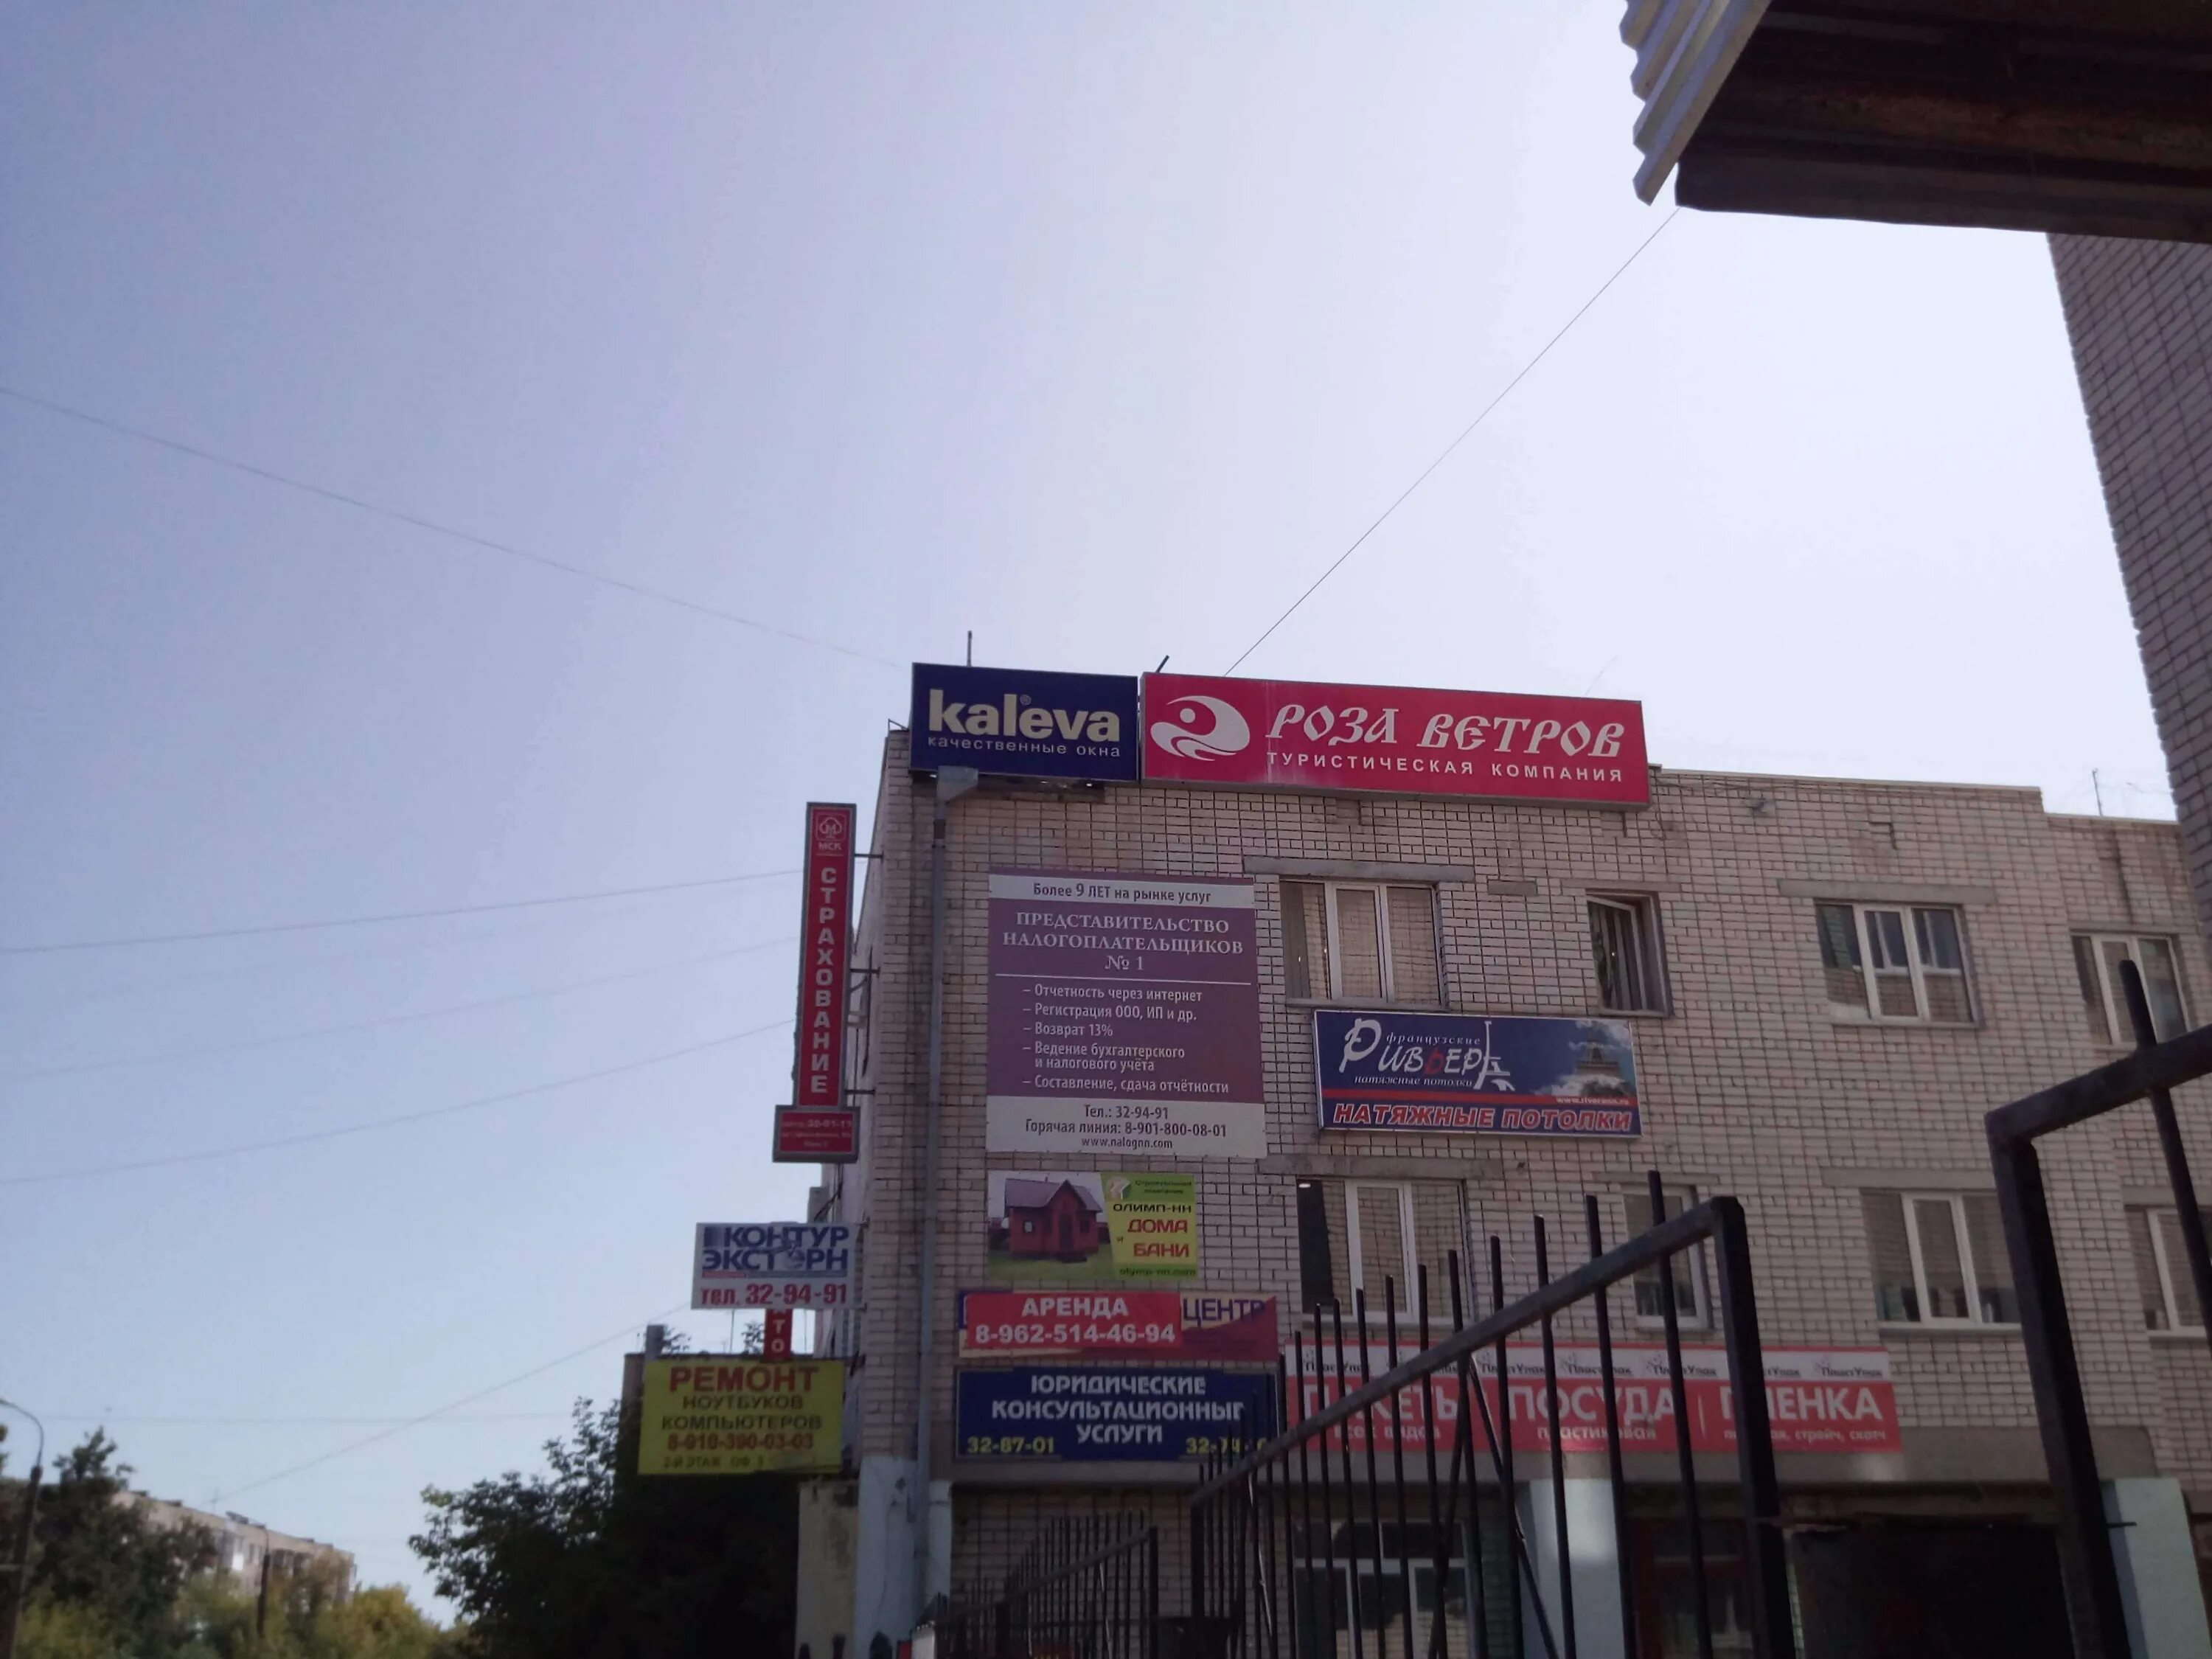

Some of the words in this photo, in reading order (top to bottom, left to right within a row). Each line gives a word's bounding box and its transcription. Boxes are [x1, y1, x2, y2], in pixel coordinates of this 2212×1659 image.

[928, 688, 1121, 743] kaleva
[1265, 703, 1399, 747] РОЗА
[1416, 713, 1625, 758] ВЕТРОВ
[928, 735, 1067, 755] качественные
[1077, 744, 1121, 757] окна
[1267, 752, 1473, 775] ТУРИСТИЧЕСКАЯ
[1492, 763, 1622, 782] КОМПАНИЯ
[1034, 883, 1071, 897] Более
[1076, 883, 1084, 897] 9
[1088, 886, 1111, 898] ЛЕТ
[1114, 888, 1129, 899] на
[1133, 890, 1174, 902] рынке
[1179, 891, 1211, 903] услуг
[1016, 911, 1229, 934] ПРЕДСТАВИТЕЛЬСТВО
[1003, 932, 1243, 956] НАЛОГОПЛАТЕЛЬЩИКОВ
[1136, 956, 1144, 970] 1
[810, 867, 837, 1093] СТРАХОВАНИЕ
[1034, 984, 1105, 998] Отчетность
[1108, 987, 1143, 1001] через
[1147, 990, 1203, 1003] интернет
[1034, 1004, 1112, 1020] Регистрация
[1147, 1006, 1164, 1019] ИП
[1167, 1009, 1175, 1020] и
[1178, 1009, 1197, 1023] др.
[1034, 1022, 1085, 1038] Возврат
[1089, 1023, 1113, 1037] 13%
[1386, 1033, 1481, 1046] французские
[1034, 1041, 1088, 1056] Ведение
[1091, 1043, 1185, 1059] бухгалтерского
[1035, 1058, 1043, 1068] и
[1046, 1059, 1116, 1070] налогового
[1034, 1075, 1118, 1091] Составление,
[1121, 1079, 1156, 1093] сдача
[1354, 1075, 1421, 1086] натяжные
[1424, 1077, 1473, 1088] потолки
[1116, 1106, 1169, 1120] 32-94-91
[1332, 1103, 1495, 1128] НАТЯЖНЫЕ
[1501, 1107, 1632, 1132] ПОТОЛКИ
[1026, 1119, 1076, 1135] Горячая
[1079, 1122, 1121, 1135] линия:
[1124, 1121, 1227, 1137] 8-901-800-08-01
[1113, 1203, 1192, 1214] ОЛИМП-НН
[1127, 1219, 1188, 1234] ДОМА
[724, 1225, 849, 1248] КОНТУР
[1133, 1242, 1189, 1258] БАНИ
[745, 1283, 847, 1305] 32-94-91
[1022, 1297, 1129, 1320] АРЕНДА
[975, 1323, 1176, 1344] 8-962-514-46-94
[669, 1366, 819, 1393] РЕМОНТ
[1032, 1374, 1207, 1394] ЮРИДИЧЕСКИЕ
[683, 1395, 804, 1411] НОУТБУКОВ
[661, 1415, 822, 1430] КОМПЬЮТЕРОВ
[1076, 1424, 1164, 1444] УСЛУГИ
